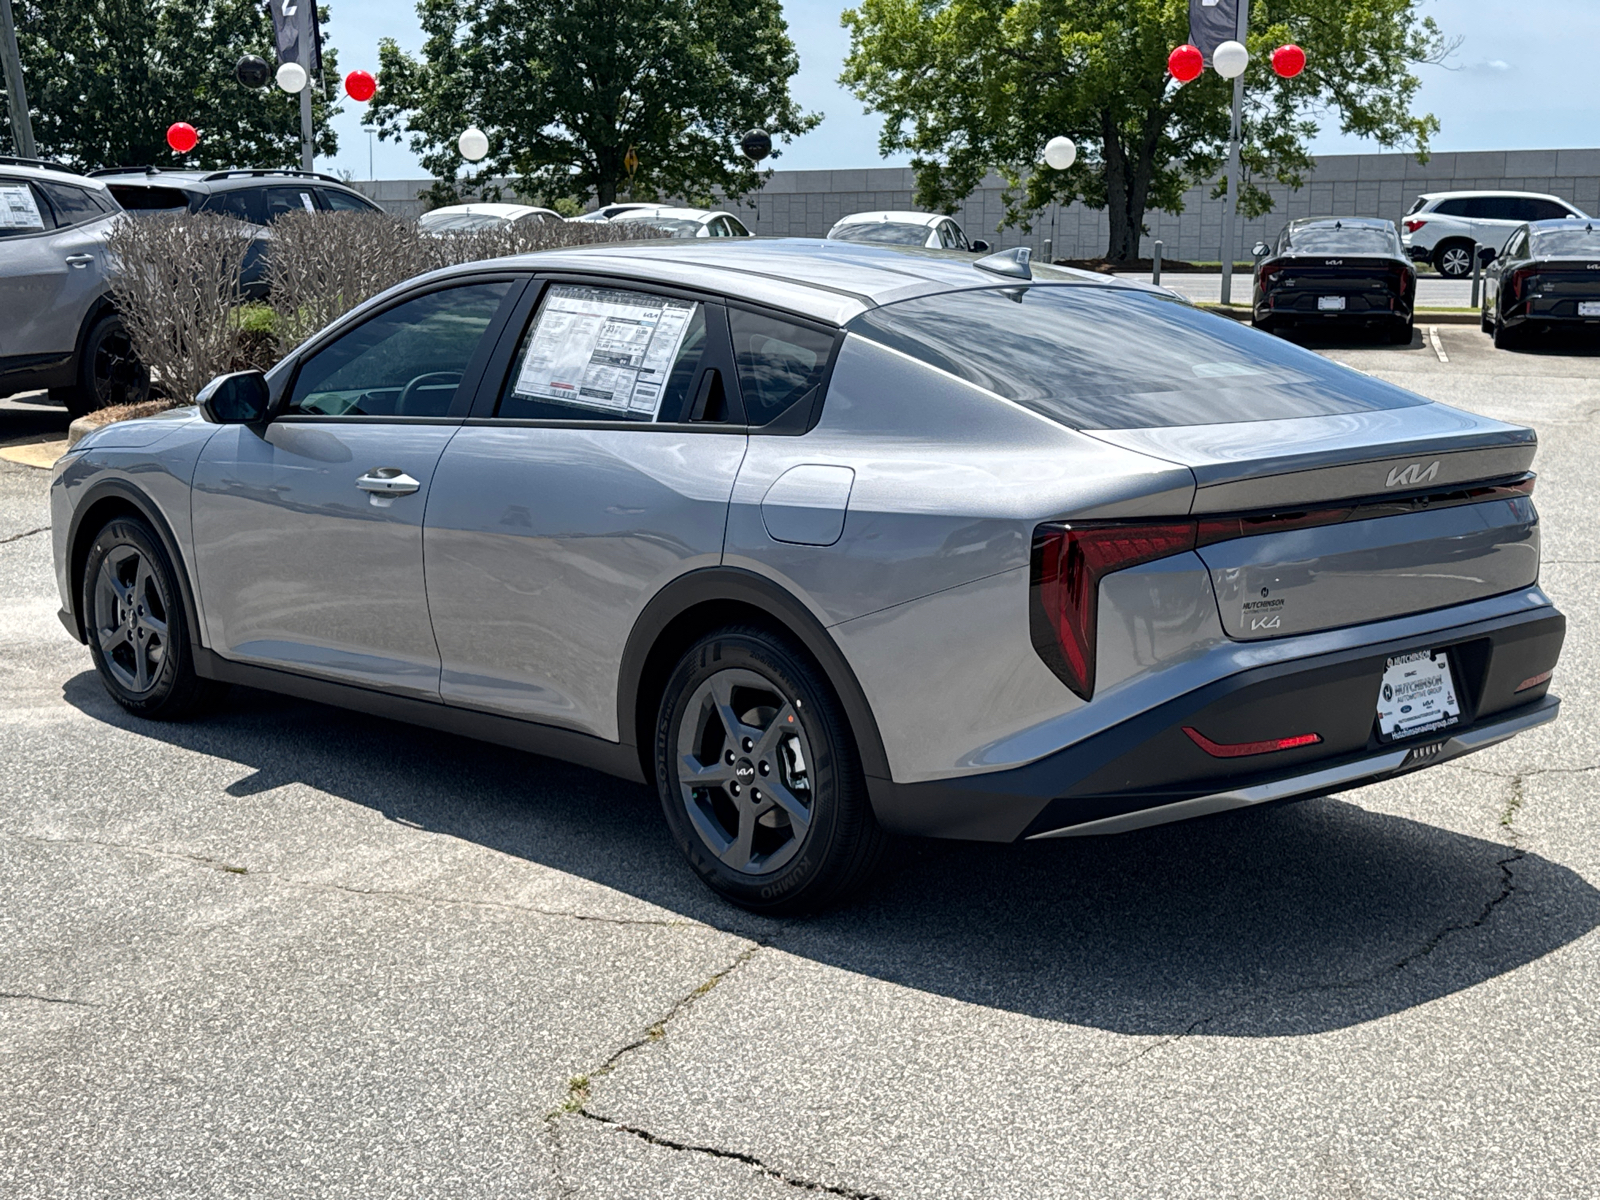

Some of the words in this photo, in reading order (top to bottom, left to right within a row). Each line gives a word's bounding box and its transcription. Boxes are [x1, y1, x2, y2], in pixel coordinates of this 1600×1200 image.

[1385, 461, 1440, 487] KIA
[1242, 598, 1285, 610] HUTCHINSON
[1251, 615, 1281, 631] K4
[1394, 650, 1431, 666] HUTCHINSON
[1395, 675, 1443, 696] HUTCHINSON
[1397, 689, 1427, 703] AUTOMOTIVE
[1427, 686, 1442, 696] GROUP
[736, 767, 754, 776] KIA
[760, 855, 812, 899] KUMHO
